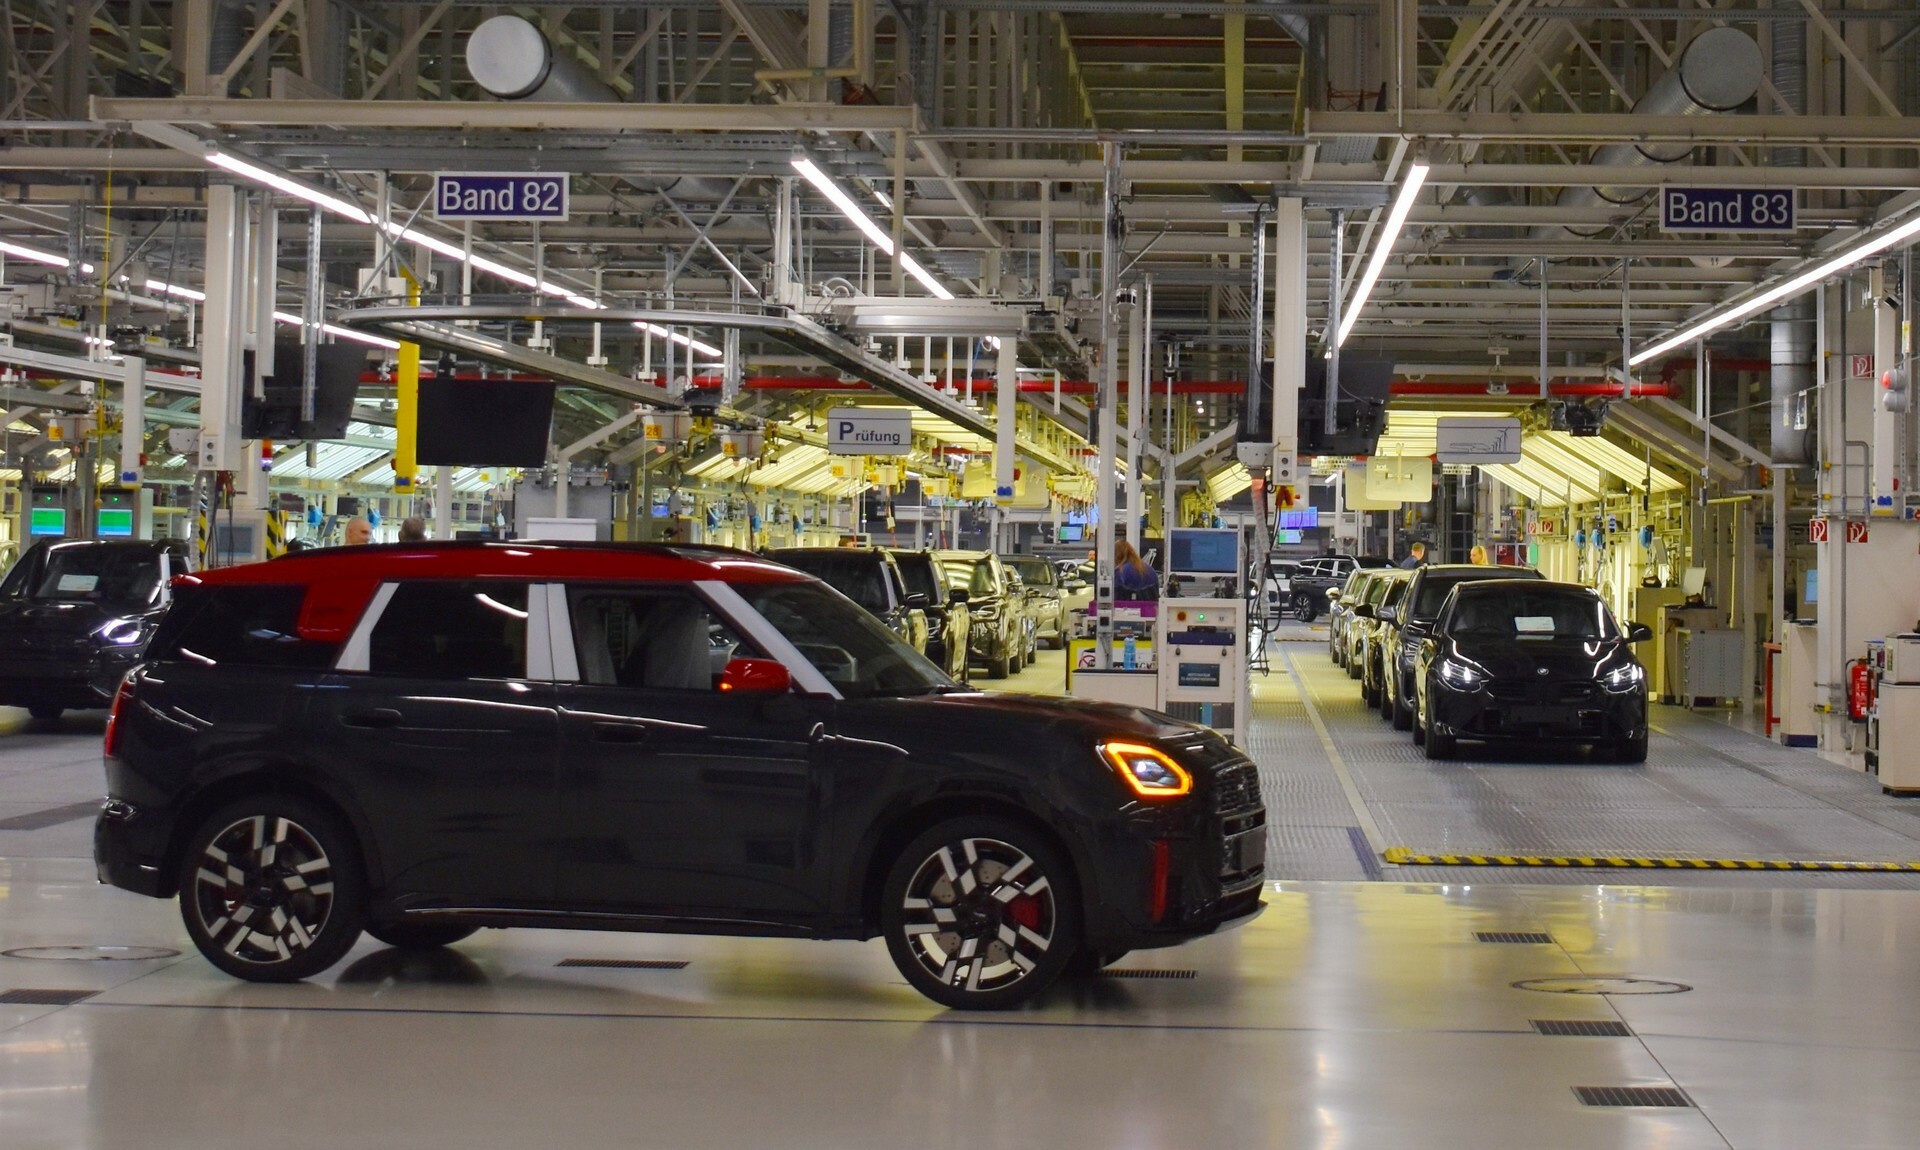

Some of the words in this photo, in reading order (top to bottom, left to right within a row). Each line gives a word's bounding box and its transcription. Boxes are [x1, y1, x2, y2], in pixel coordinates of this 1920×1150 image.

[441, 181, 514, 211] Band
[522, 181, 559, 211] 82
[1669, 193, 1742, 223] Band
[1751, 194, 1788, 224] 83
[646, 426, 659, 436] 28
[839, 421, 900, 445] Prüfung
